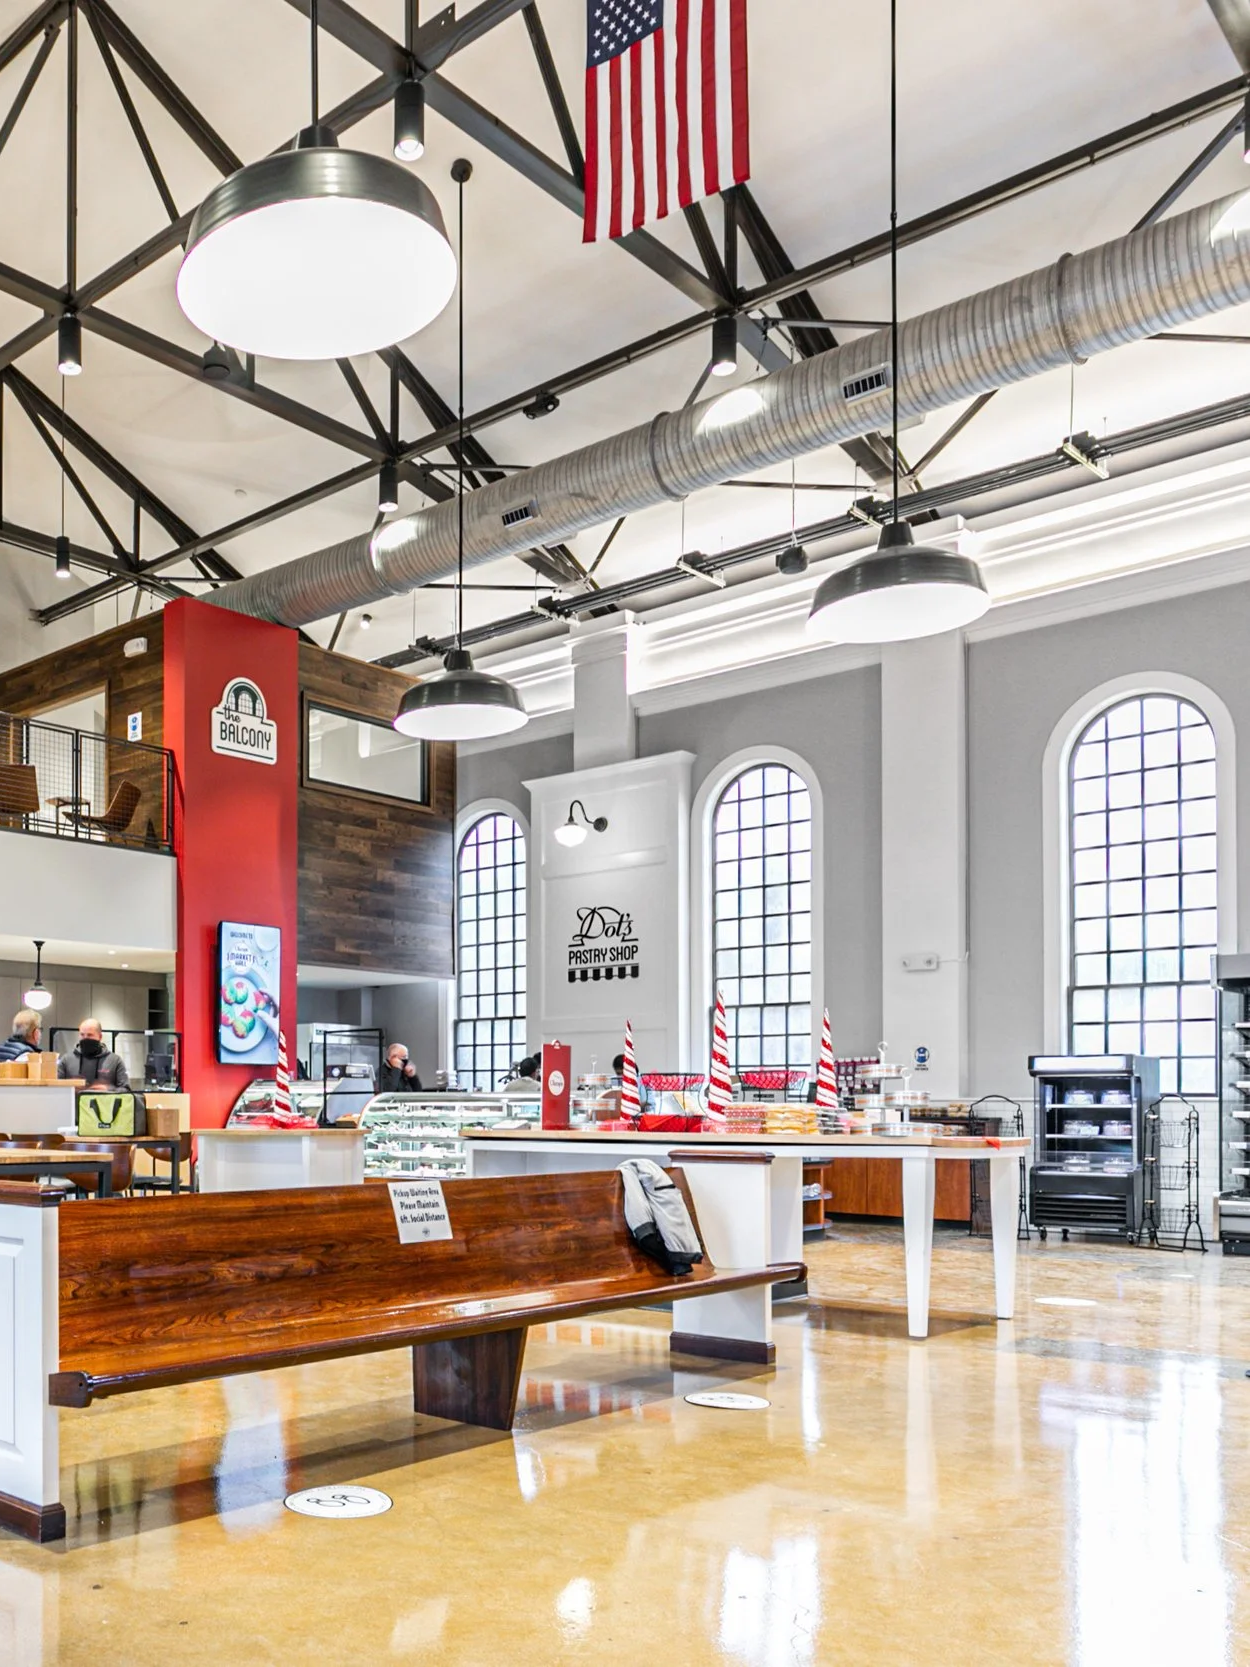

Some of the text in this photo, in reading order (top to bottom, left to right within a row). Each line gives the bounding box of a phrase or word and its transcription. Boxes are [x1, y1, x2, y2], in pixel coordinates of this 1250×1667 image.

[222, 703, 241, 724] the
[220, 722, 271, 750] BALCONY
[572, 906, 634, 941] Dot's
[569, 945, 638, 965] PASTRY SHOP
[393, 1187, 439, 1198] Pickup Waiting Area
[400, 1200, 439, 1209] Please Maintain
[411, 1213, 424, 1222] Social
[425, 1213, 445, 1221] Distance
